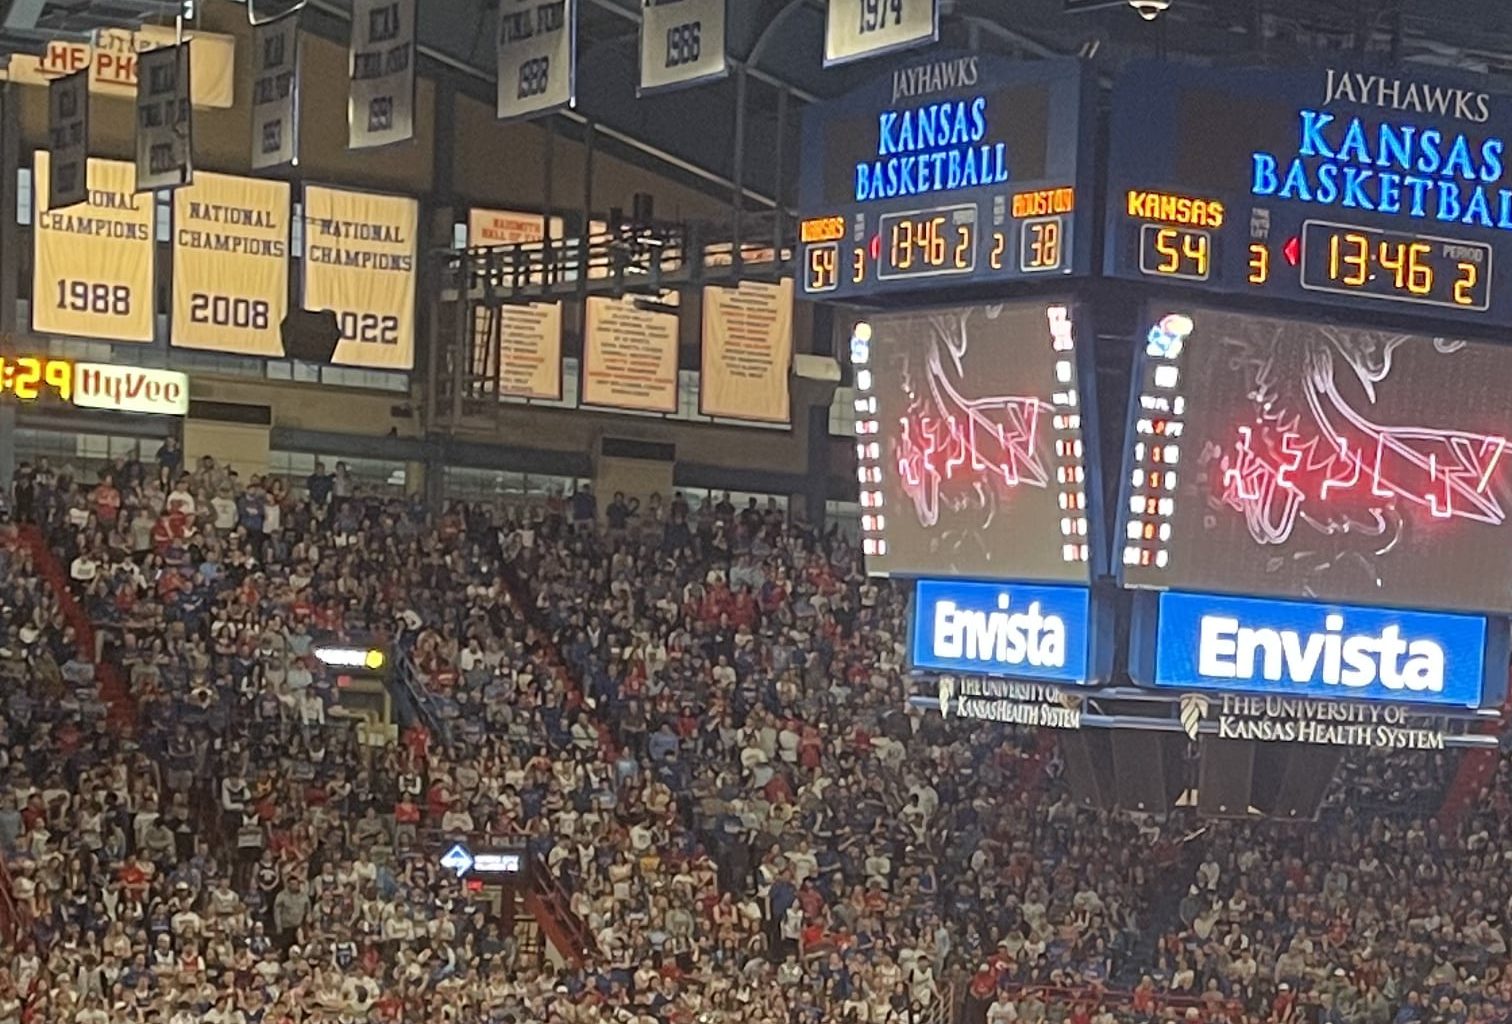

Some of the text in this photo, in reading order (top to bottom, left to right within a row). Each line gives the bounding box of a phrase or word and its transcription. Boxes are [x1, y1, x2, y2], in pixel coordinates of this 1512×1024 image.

[97, 53, 138, 80] PH
[892, 56, 978, 104] JAYHAWKS
[1323, 68, 1491, 123] JAYHAWKS
[878, 97, 986, 155] KANSAS
[1299, 109, 1505, 185] KANSAS
[855, 143, 1008, 201] BASKETBALL
[39, 211, 148, 241] CHAMPIONS
[189, 202, 276, 228] NATIONAL
[1126, 190, 1225, 229] KANSAS
[178, 229, 284, 258] CHAMPIONS
[319, 219, 405, 244] NATIONAL
[955, 227, 969, 268] 2
[1031, 223, 1057, 267] 38
[309, 244, 412, 272] CHAMPIONS
[811, 250, 836, 288] 54
[852, 247, 865, 283] 3
[990, 232, 1004, 270] 2
[1155, 228, 1208, 276] 54
[1248, 243, 1269, 285] 3
[1328, 232, 1433, 296] 13:46
[1442, 243, 1485, 264] PERIOD
[56, 279, 131, 316] 1988
[1453, 261, 1479, 307] 2
[190, 293, 269, 330] 2008
[339, 311, 399, 345] 022
[0, 357, 71, 401] :29
[933, 592, 1065, 668] Envista
[1199, 610, 1446, 693] Envista
[956, 697, 1081, 730] KANSAS HEALTH SYSTEM
[1219, 693, 1410, 724] THE UNIVERSITY OF
[1218, 719, 1445, 750] KANSAS HEALTH SYSTEM
